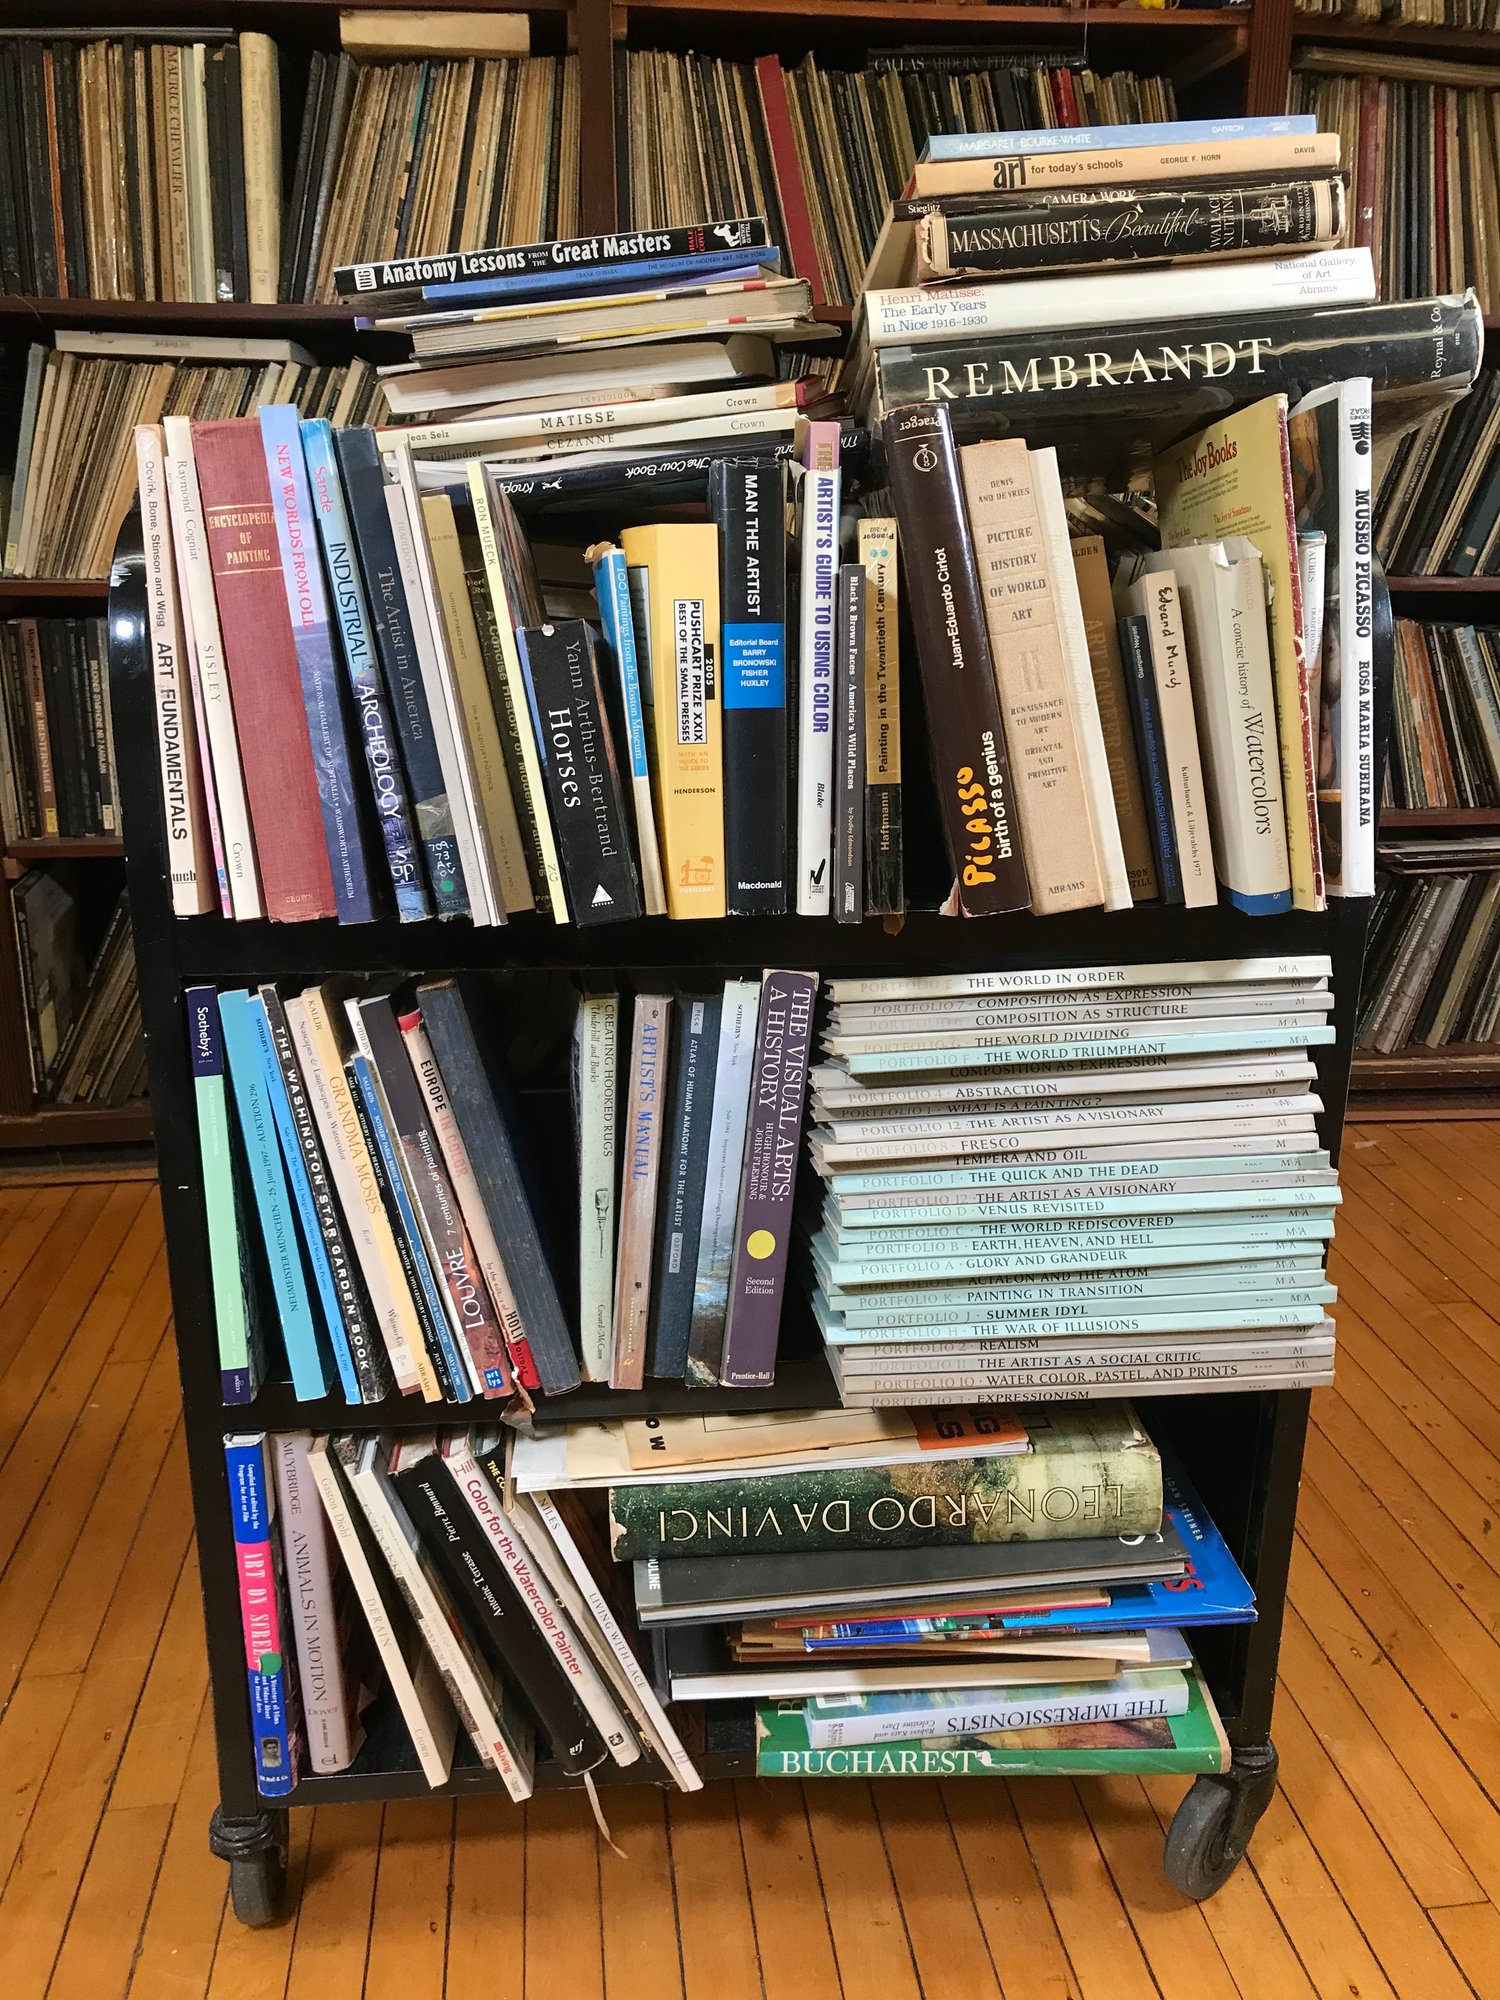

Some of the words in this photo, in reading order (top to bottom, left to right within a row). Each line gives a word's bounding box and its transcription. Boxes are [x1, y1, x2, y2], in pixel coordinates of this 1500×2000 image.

[167, 49, 181, 116] MAURICE
[959, 138, 1014, 151] MARGARET
[1020, 133, 1092, 148] BOURKE-WHITE
[1160, 156, 1189, 165] GEORGE
[1191, 155, 1198, 163] F.
[1201, 153, 1222, 162] HORN
[1294, 145, 1316, 155] DAVIS
[992, 155, 1031, 189] art
[1031, 164, 1045, 174] for
[1049, 162, 1084, 174] today's
[1087, 159, 1124, 170] schools
[907, 202, 941, 214] Stieglitz
[603, 233, 672, 258] Masters
[951, 215, 1100, 253] MASSACHUSETTS
[1104, 207, 1200, 247] Beautiful
[461, 250, 526, 275] Lessons
[528, 250, 549, 260] FROM
[533, 259, 547, 267] THE
[552, 238, 600, 264] Great
[382, 260, 457, 283] Anatomy
[880, 292, 922, 306] Henri
[926, 286, 985, 302] Matisse:
[881, 306, 906, 319] The
[910, 303, 948, 317] Early
[950, 299, 987, 312] Years
[882, 320, 897, 333] in
[899, 318, 929, 331] Nice
[922, 336, 1273, 402] REMBRANDT
[540, 410, 616, 429] MATISSE
[726, 396, 757, 407] Crown
[730, 418, 765, 431] Crown
[145, 460, 156, 497] Ocvirk,
[276, 444, 293, 480] NEW
[475, 497, 488, 523] RON
[745, 474, 759, 513] MAN
[149, 501, 158, 531] Bone,
[282, 485, 303, 549] WORLDS
[815, 476, 834, 549] ARTIST'S
[1354, 488, 1371, 556] MUSEO
[239, 531, 253, 545] OF
[481, 526, 497, 566] MUECK
[746, 518, 760, 551] THE
[986, 526, 1033, 544] PICTURE
[151, 534, 161, 574] Stinson
[226, 549, 271, 565] PAINTING
[935, 548, 951, 584] Cirlot
[990, 553, 1037, 571] HISTORY
[154, 576, 164, 597] and
[293, 552, 312, 596] FROM
[377, 566, 395, 602] The
[746, 555, 761, 616] ARTIST
[814, 556, 833, 600] GUIDE
[989, 586, 1004, 598] OF
[1007, 579, 1047, 595] WORLD
[156, 600, 166, 627] Wigg
[299, 596, 316, 632] OLD
[813, 604, 832, 625] TO
[1011, 608, 1033, 622] ART
[1355, 560, 1372, 640] PICASSO
[386, 605, 406, 650] Artist
[690, 601, 702, 672] PUSHCART
[941, 584, 964, 669] Juan-Eduardo
[157, 641, 174, 679] ART
[396, 653, 411, 670] in
[813, 628, 832, 678] USING
[203, 645, 222, 704] SISLEY
[329, 542, 368, 664] INDUSTRIAL
[358, 683, 401, 819] ARCHEOLOGY
[705, 657, 714, 686] 2005
[1358, 660, 1370, 697] ROSA
[401, 676, 425, 742] America
[692, 674, 703, 708] PRIZE
[812, 678, 830, 734] COLOR
[693, 711, 704, 742] XXIX
[1358, 699, 1371, 750] MARIA
[160, 688, 188, 840] FUNDAMENTALS
[548, 708, 581, 809] Horses
[565, 640, 583, 690] Yann
[576, 697, 618, 858] Arthus-Bertrand
[981, 730, 1004, 788] genius
[674, 786, 716, 795] HENDERSON
[1243, 711, 1277, 835] Watercolors
[1359, 754, 1371, 827] SUBIRANA
[990, 800, 1007, 820] of
[991, 788, 1003, 800] a
[994, 820, 1013, 860] birth
[737, 880, 782, 891] Macdonald
[769, 986, 788, 1003] A
[966, 977, 995, 989] THE
[998, 973, 1052, 987] WORLD
[1056, 973, 1071, 985] IN
[1077, 971, 1126, 983] ORDER
[788, 988, 812, 1037] THE
[975, 1010, 1078, 1027] COMPOSITION
[1082, 1008, 1101, 1020] AS
[1105, 1004, 1189, 1019] STRUCTURE
[197, 1006, 213, 1057] Sotheby's
[604, 1004, 615, 1066] CREATING
[639, 1022, 659, 1102] ARTIST'S
[758, 1010, 787, 1111] HISTORY
[420, 1059, 447, 1113] EUROPE
[603, 1066, 614, 1122] HOOKED
[778, 1045, 807, 1131] VISUAL
[955, 1083, 1059, 1099] ABSTRACTION
[329, 1075, 363, 1160] GRANDMA
[354, 1162, 381, 1215] MOSES
[603, 1123, 613, 1158] RUGS
[633, 1110, 653, 1181] MANUAL
[960, 1136, 1020, 1151] FRESCO
[770, 1134, 796, 1203] ARTS:
[274, 1025, 291, 1060] THE
[287, 1068, 325, 1186] WASHINGTON
[318, 1195, 337, 1239] STAR
[331, 1245, 357, 1315] GARDEN
[351, 1325, 370, 1370] BOOK
[978, 1204, 1028, 1216] VENUS
[1033, 1201, 1105, 1214] REVISITED
[445, 1246, 485, 1330] LOUVRE
[744, 1285, 774, 1295] Edition
[745, 1276, 774, 1287] Second
[986, 1307, 1050, 1321] SUMMER
[1055, 1305, 1088, 1317] IDYL
[986, 1374, 1034, 1387] WATER
[1039, 1371, 1092, 1384] COLOR,
[1095, 1369, 1150, 1382] PASTEL,
[1152, 1366, 1184, 1379] AND
[1189, 1364, 1239, 1377] PRINTS
[282, 1441, 302, 1516] MUYBRIDGE
[658, 1505, 783, 1542] VINCI
[792, 1499, 851, 1534] DA
[867, 1483, 1124, 1532] LEONARDO
[292, 1529, 316, 1611] ANIMALS
[466, 1478, 493, 1517] Color
[486, 1515, 505, 1540] for
[498, 1536, 517, 1561] the
[512, 1558, 558, 1635] Watercolor
[551, 1630, 584, 1676] Painter
[304, 1615, 319, 1631] IN
[589, 1591, 612, 1632] LIVING
[610, 1631, 631, 1664] WITH
[627, 1662, 647, 1689] LACE
[307, 1635, 328, 1702] MOTION
[946, 1702, 1119, 1733] IMPRESSIONISTS
[1126, 1697, 1168, 1716] THE
[779, 1749, 977, 1775] BUCHAREST
